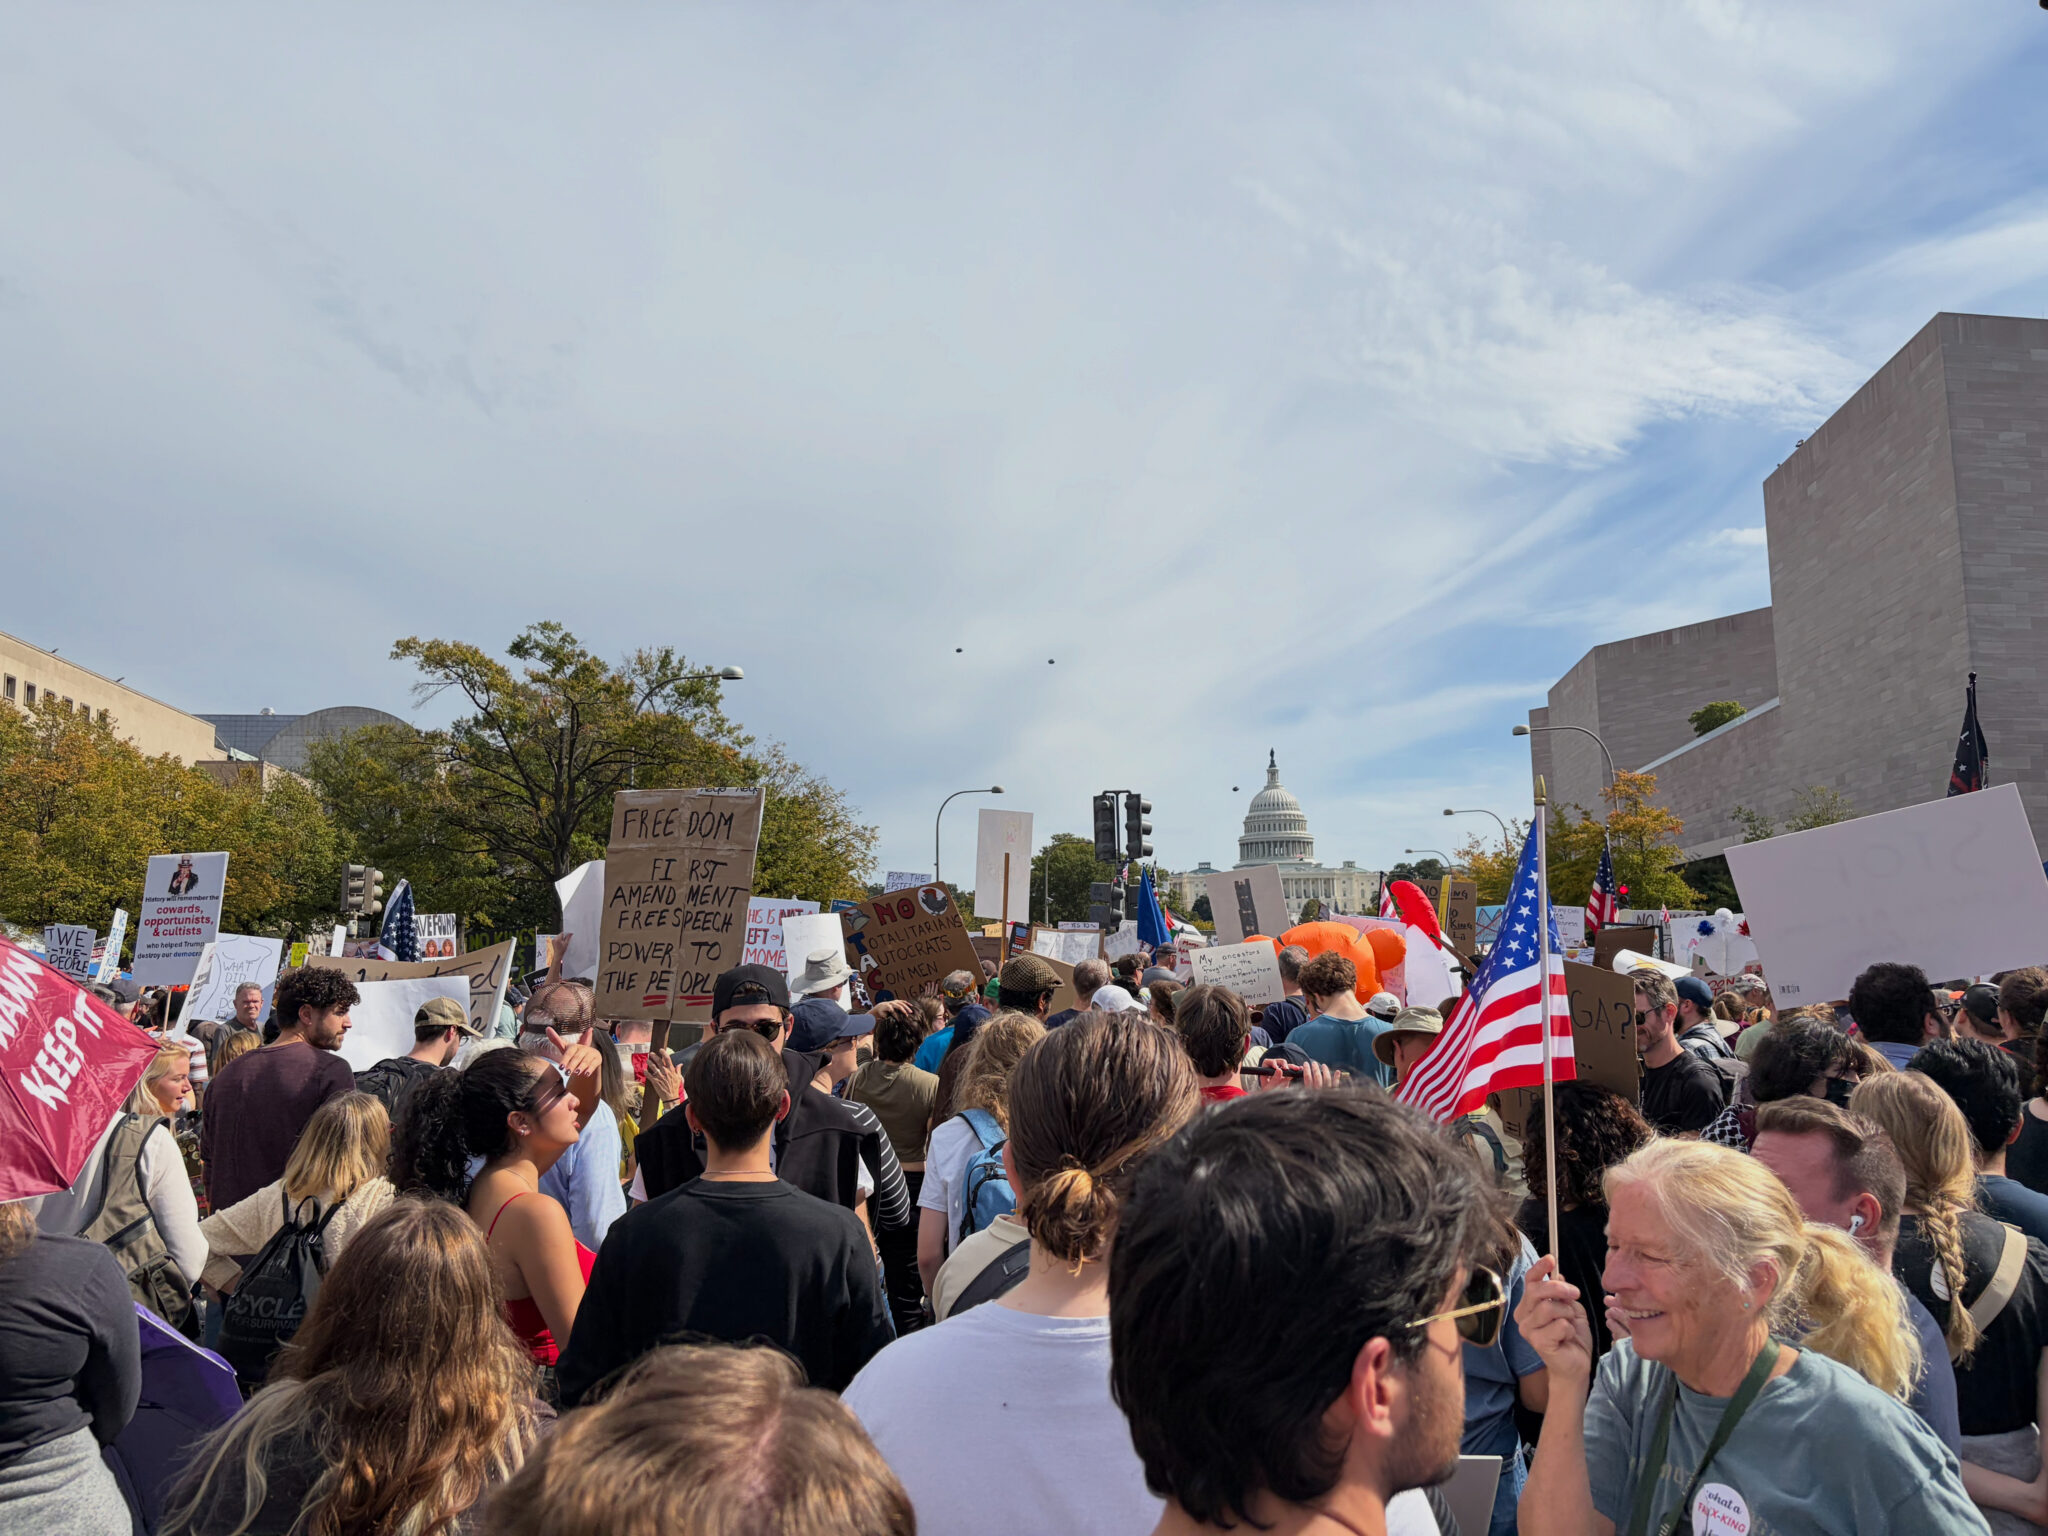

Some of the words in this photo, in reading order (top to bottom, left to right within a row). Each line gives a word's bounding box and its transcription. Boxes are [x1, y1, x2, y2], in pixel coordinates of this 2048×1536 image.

[651, 858, 728, 882] FIRST
[887, 872, 903, 880] FOR
[910, 873, 926, 883] THE
[609, 885, 749, 908] AMENDMENT
[1450, 889, 1469, 900] NG
[156, 904, 204, 915] cowards,
[747, 908, 763, 924] HIS
[767, 909, 776, 924] IS
[872, 898, 915, 926] NO
[144, 914, 214, 928] opportunists,
[416, 915, 433, 937] AVE
[618, 908, 671, 929] FREE
[672, 907, 733, 933] SPEECH
[57, 927, 88, 948] WE
[152, 927, 160, 937] &
[162, 927, 202, 936] cultists
[746, 928, 769, 944] EFT
[847, 914, 962, 954] TOTALITARIANS
[50, 954, 89, 973] PEOPLE
[608, 942, 672, 968] POWER
[691, 941, 722, 965] TO
[744, 947, 788, 968] MOME
[860, 935, 952, 973] AUTOCRATS
[1199, 954, 1213, 965] My
[1222, 950, 1260, 960] ancestors
[223, 960, 253, 972] WHAT
[907, 961, 938, 979] MEN
[224, 972, 246, 983] DID
[604, 970, 638, 994] THE
[645, 970, 715, 995] PEOPL
[223, 984, 237, 996] YO
[1570, 990, 1632, 1040] GA?
[20, 1017, 84, 1111] KEEP
[234, 1293, 304, 1318] CYCLE
[1733, 1505, 1742, 1515] a
